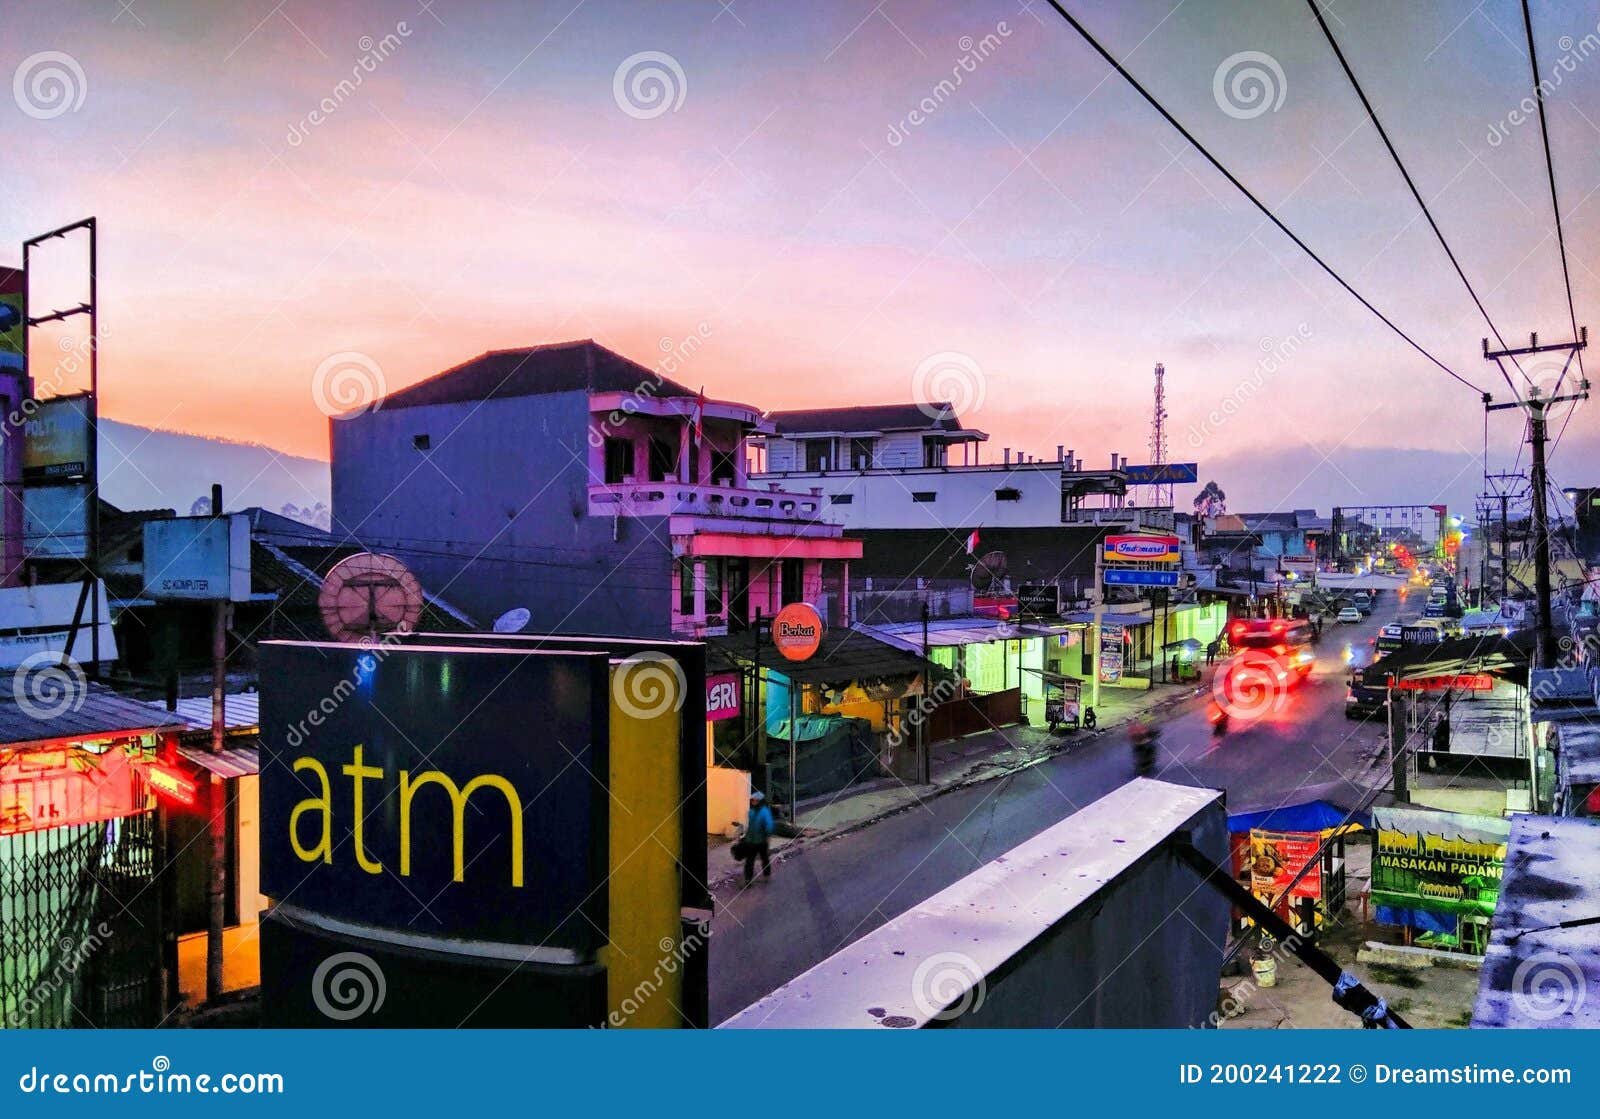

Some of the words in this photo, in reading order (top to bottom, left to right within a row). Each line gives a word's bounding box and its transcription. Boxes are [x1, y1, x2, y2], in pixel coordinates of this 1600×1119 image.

[1119, 543, 1165, 553] Indomaret
[780, 622, 816, 637] Berkat
[289, 743, 523, 888] atm
[1380, 855, 1446, 873] MASAKAN
